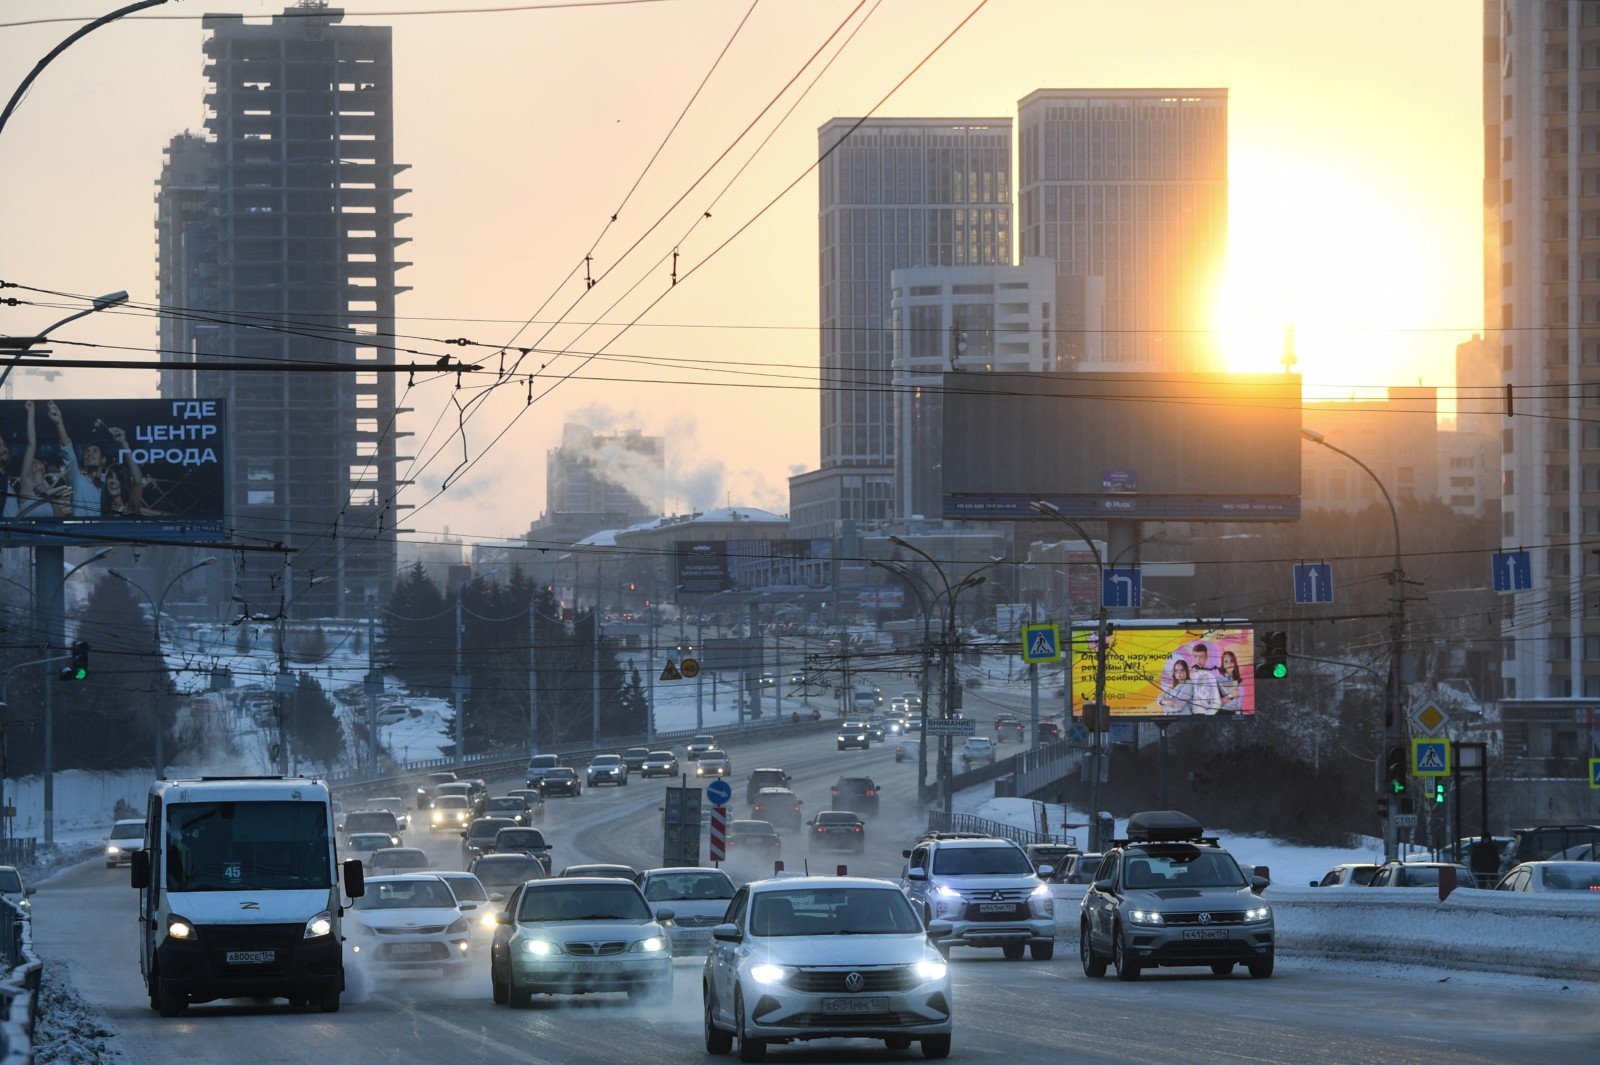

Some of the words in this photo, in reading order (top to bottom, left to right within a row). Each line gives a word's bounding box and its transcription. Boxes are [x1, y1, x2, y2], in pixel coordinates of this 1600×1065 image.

[173, 401, 217, 420] ГДЕ
[136, 425, 217, 444] ЦЕНТР
[118, 448, 217, 466] ГОРОДА
[1127, 653, 1172, 662] наружной
[1394, 817, 1416, 825] СТОП
[225, 866, 241, 878] 45
[240, 902, 260, 910] Z
